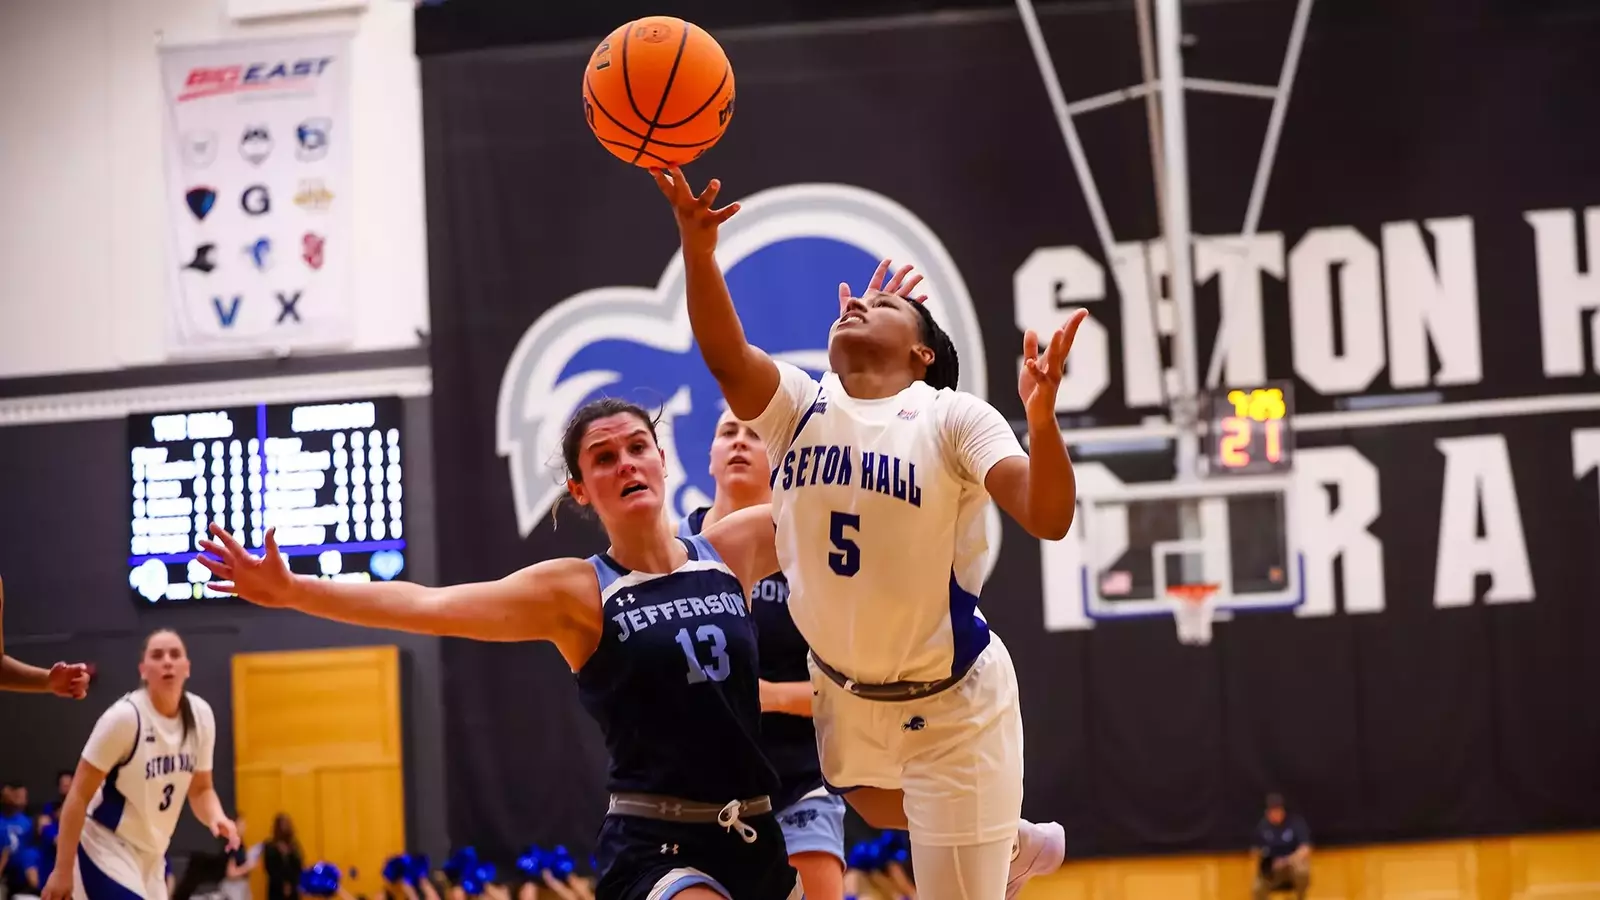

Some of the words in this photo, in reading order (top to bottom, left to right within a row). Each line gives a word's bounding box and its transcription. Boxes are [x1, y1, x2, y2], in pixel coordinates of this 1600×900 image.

[240, 184, 271, 216] G
[212, 295, 242, 327] V
[275, 290, 304, 326] X
[1013, 214, 1484, 412] SETON
[1220, 416, 1282, 467] 21
[782, 445, 852, 491] SETON
[861, 451, 922, 508] HALL
[828, 510, 861, 578] 5
[612, 592, 747, 642] JEFFERSON
[675, 624, 731, 684] 13
[159, 783, 175, 812] 3
